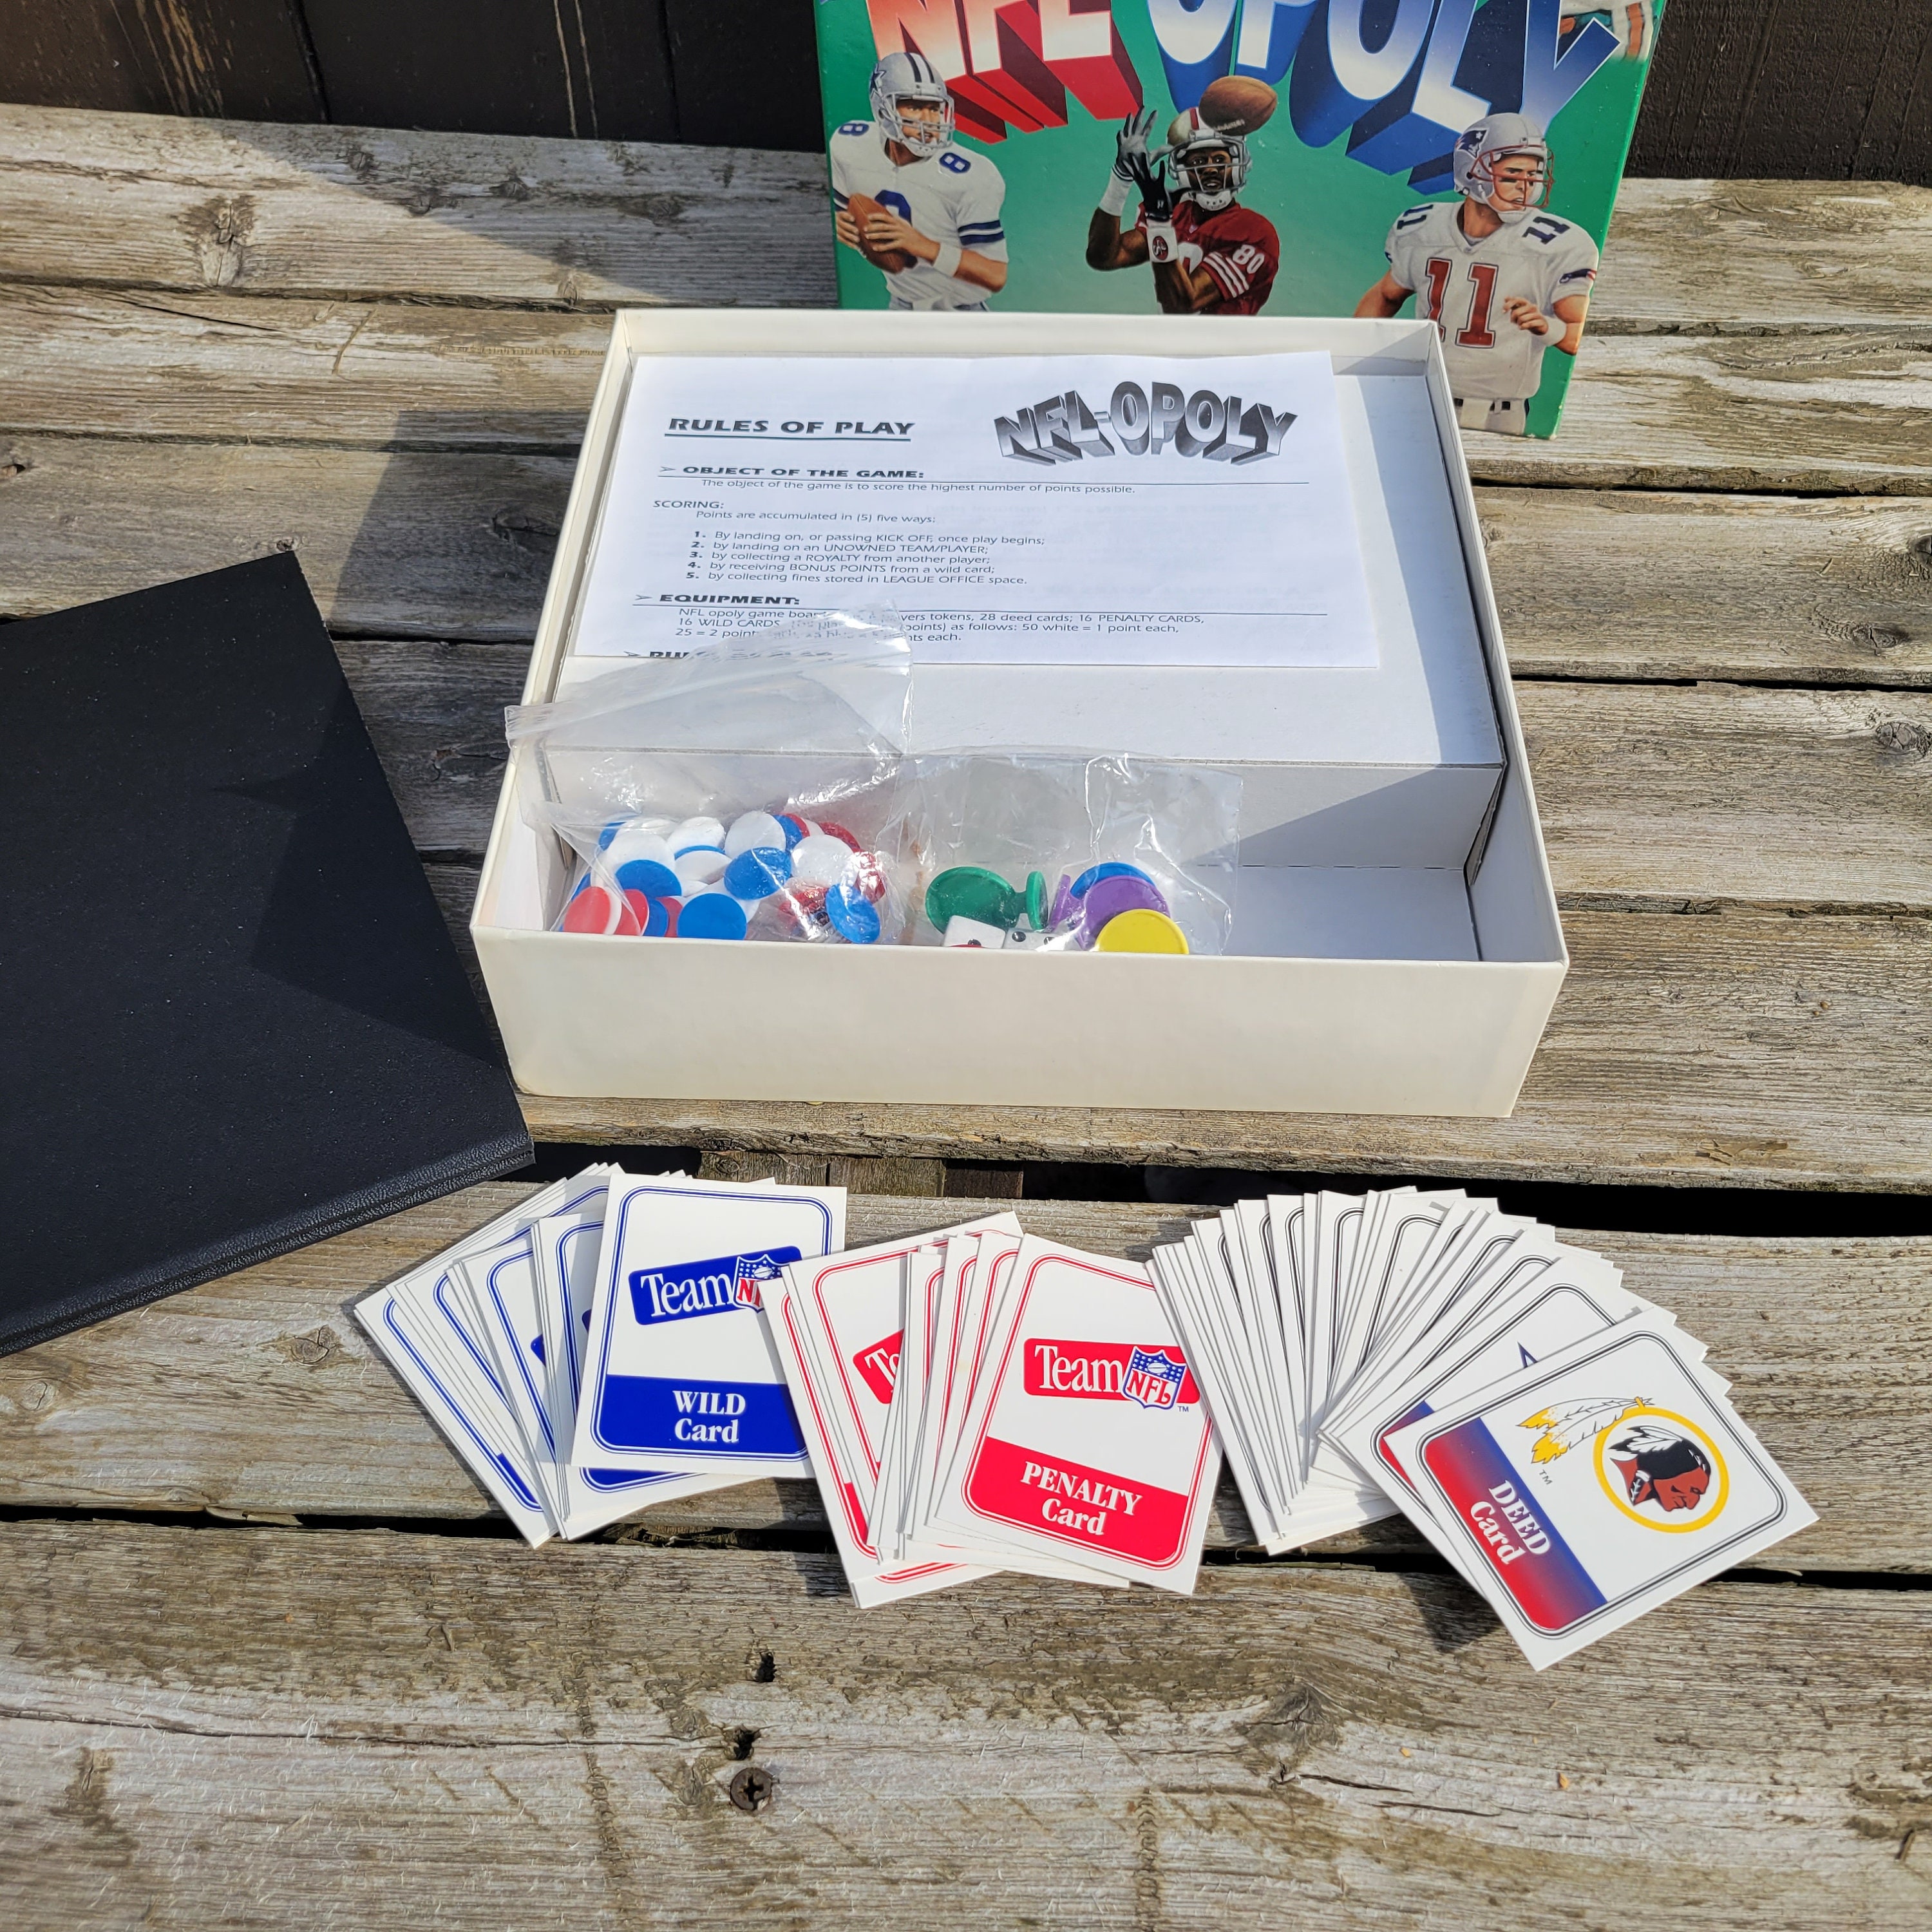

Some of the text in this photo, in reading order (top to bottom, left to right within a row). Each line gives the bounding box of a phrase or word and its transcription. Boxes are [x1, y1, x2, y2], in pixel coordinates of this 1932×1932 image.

[939, 152, 971, 173] 8
[1522, 216, 1570, 245] 11
[1233, 244, 1264, 274] 80
[1425, 258, 1499, 348] 11
[668, 417, 916, 435] RULES OF PLAY
[994, 381, 1299, 466] NFL-OPOLY
[683, 466, 924, 478] OBJECT OF THE GAME:
[727, 480, 764, 489] object
[931, 484, 975, 493] highest
[1029, 484, 1042, 492] of
[1045, 485, 1081, 494] points
[1084, 486, 1135, 495] possible.
[652, 500, 724, 509] SCORING:
[759, 512, 837, 520] accumulated
[857, 513, 872, 523] (5)
[876, 514, 898, 522] five
[901, 516, 936, 525] ways:
[715, 531, 731, 541] By
[734, 531, 781, 542] landing
[826, 533, 872, 544] passing
[876, 534, 904, 542] KICK
[972, 535, 998, 545] play
[1001, 536, 1045, 546] begins;
[713, 541, 729, 551] by
[732, 542, 779, 553] landing
[824, 544, 896, 553] UNOWNED
[899, 544, 989, 554] TEAM/PLAYER;
[712, 551, 728, 561] by
[731, 553, 790, 563] collecting
[806, 554, 861, 562] ROYALTY
[896, 555, 946, 564] another
[949, 556, 990, 565] player;
[710, 562, 726, 571] by
[729, 563, 785, 573] receiving
[789, 564, 836, 573] BONUS
[840, 564, 886, 573] POINTS
[891, 565, 919, 573] from
[965, 565, 995, 574] card;
[708, 572, 724, 582] by
[727, 573, 788, 583] collecting
[792, 573, 821, 582] fines
[824, 574, 864, 583] stored
[867, 574, 879, 583] in
[883, 575, 934, 583] LEAGUE
[938, 575, 985, 583] OFFICE
[989, 577, 1027, 585] space.
[659, 594, 800, 605] EQUIPMENT:
[679, 608, 705, 616] NFL
[708, 609, 745, 620] opoly
[748, 611, 785, 620] game
[930, 612, 974, 621] tokens,
[1036, 614, 1073, 623] cards;
[1080, 614, 1092, 622] 16
[1158, 615, 1204, 624] CARDS,
[674, 628, 692, 636] 25
[709, 629, 718, 637] 2
[927, 632, 961, 641] each.
[679, 618, 693, 626] 16
[698, 618, 733, 627] WILD
[969, 623, 1018, 632] follows:
[1042, 623, 1079, 632] white
[1097, 623, 1101, 632] 1
[1108, 624, 1142, 634] point
[1145, 624, 1179, 633] each,
[640, 1273, 734, 1317] Team
[1034, 1345, 1123, 1393] Team
[1127, 1370, 1171, 1405] NFL
[672, 1390, 746, 1415] WILD
[674, 1417, 739, 1443] Card
[1539, 1469, 1553, 1485] TM
[1020, 1461, 1142, 1516] PENALTY
[1042, 1498, 1107, 1535] Card
[1488, 1479, 1551, 1555] DEED
[1471, 1501, 1526, 1564] Card
